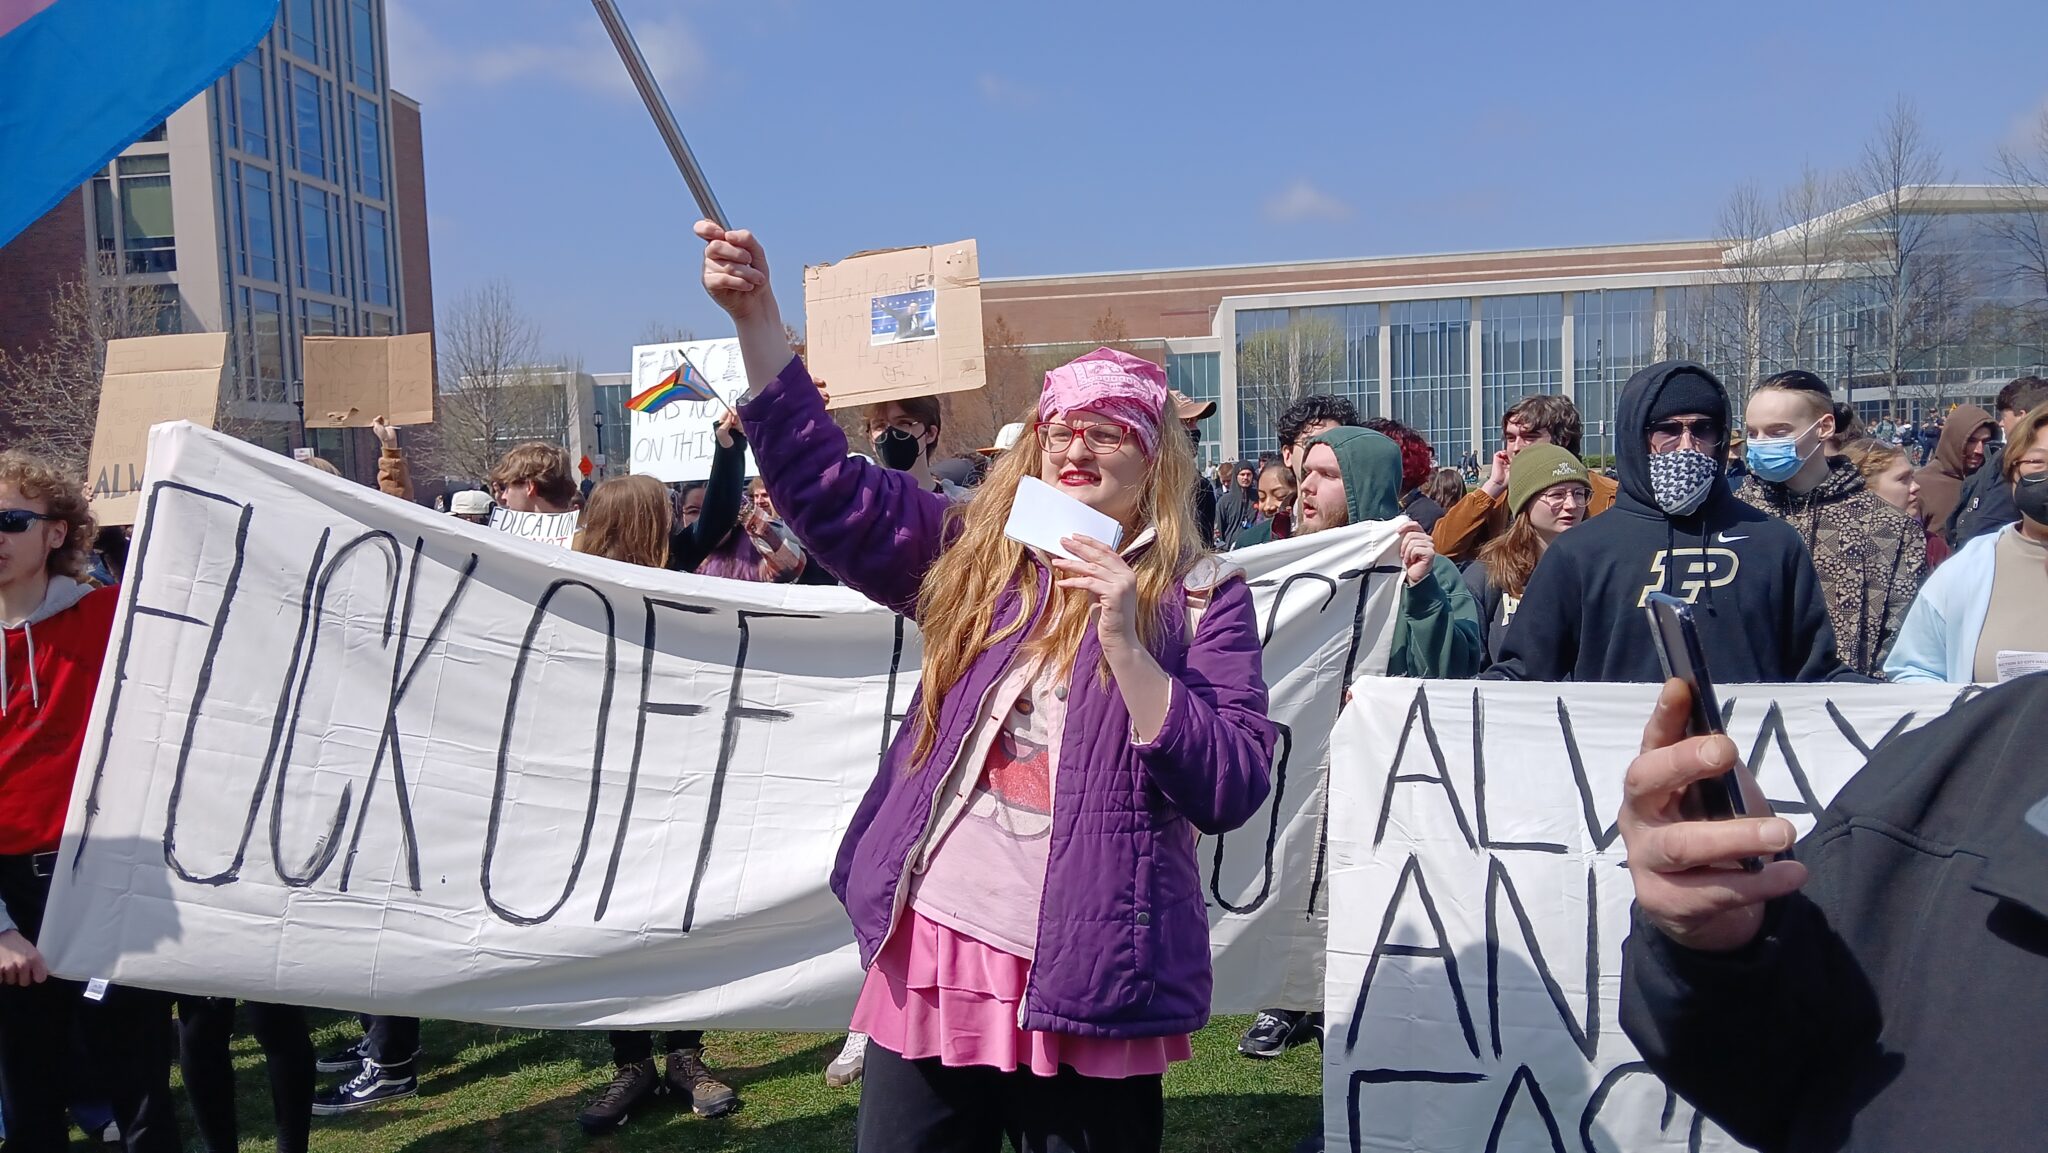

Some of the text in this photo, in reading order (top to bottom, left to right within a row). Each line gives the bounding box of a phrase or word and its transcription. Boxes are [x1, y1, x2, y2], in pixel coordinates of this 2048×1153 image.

[634, 438, 664, 463] ON
[74, 480, 480, 894] FUCK
[481, 578, 825, 932] OFF
[1374, 684, 1988, 853] ALWAY
